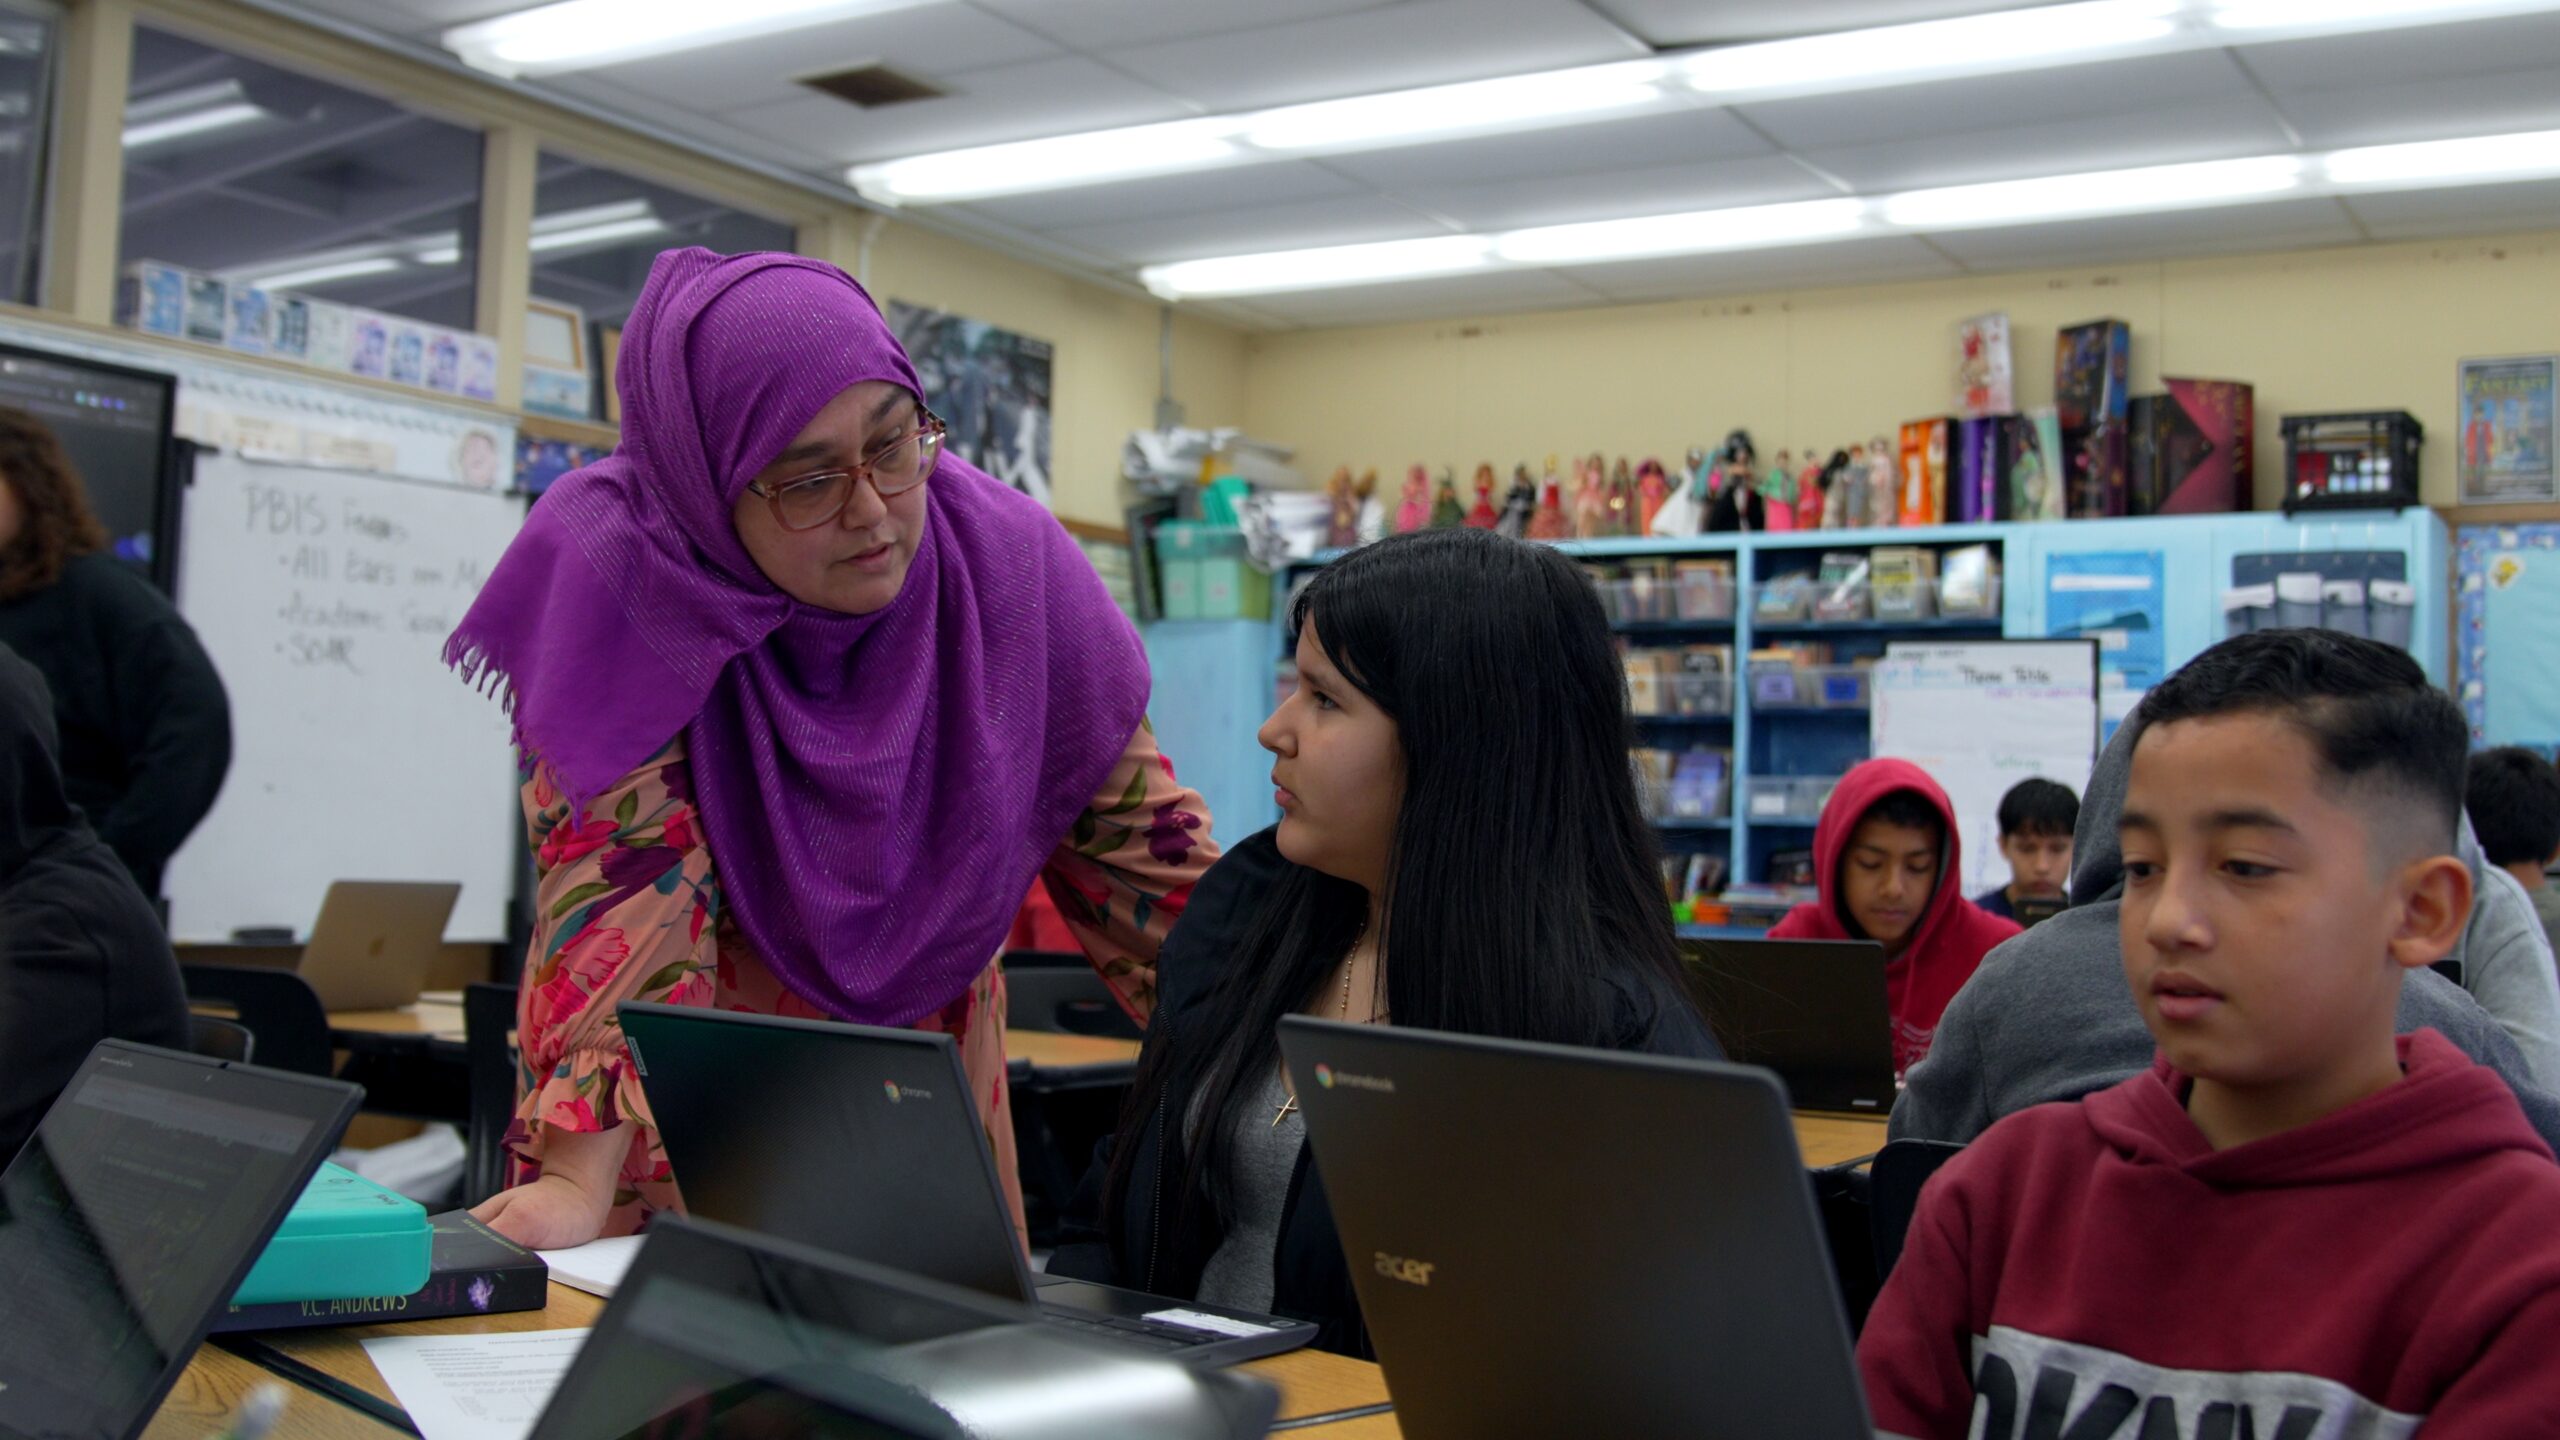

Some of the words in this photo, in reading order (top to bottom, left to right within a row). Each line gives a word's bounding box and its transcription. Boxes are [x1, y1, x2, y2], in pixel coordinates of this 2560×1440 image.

[242, 482, 326, 536] PBIS
[1374, 1251, 1435, 1286] acer
[331, 1296, 407, 1314] ANDREWS
[1973, 1353, 2323, 1440] DK
